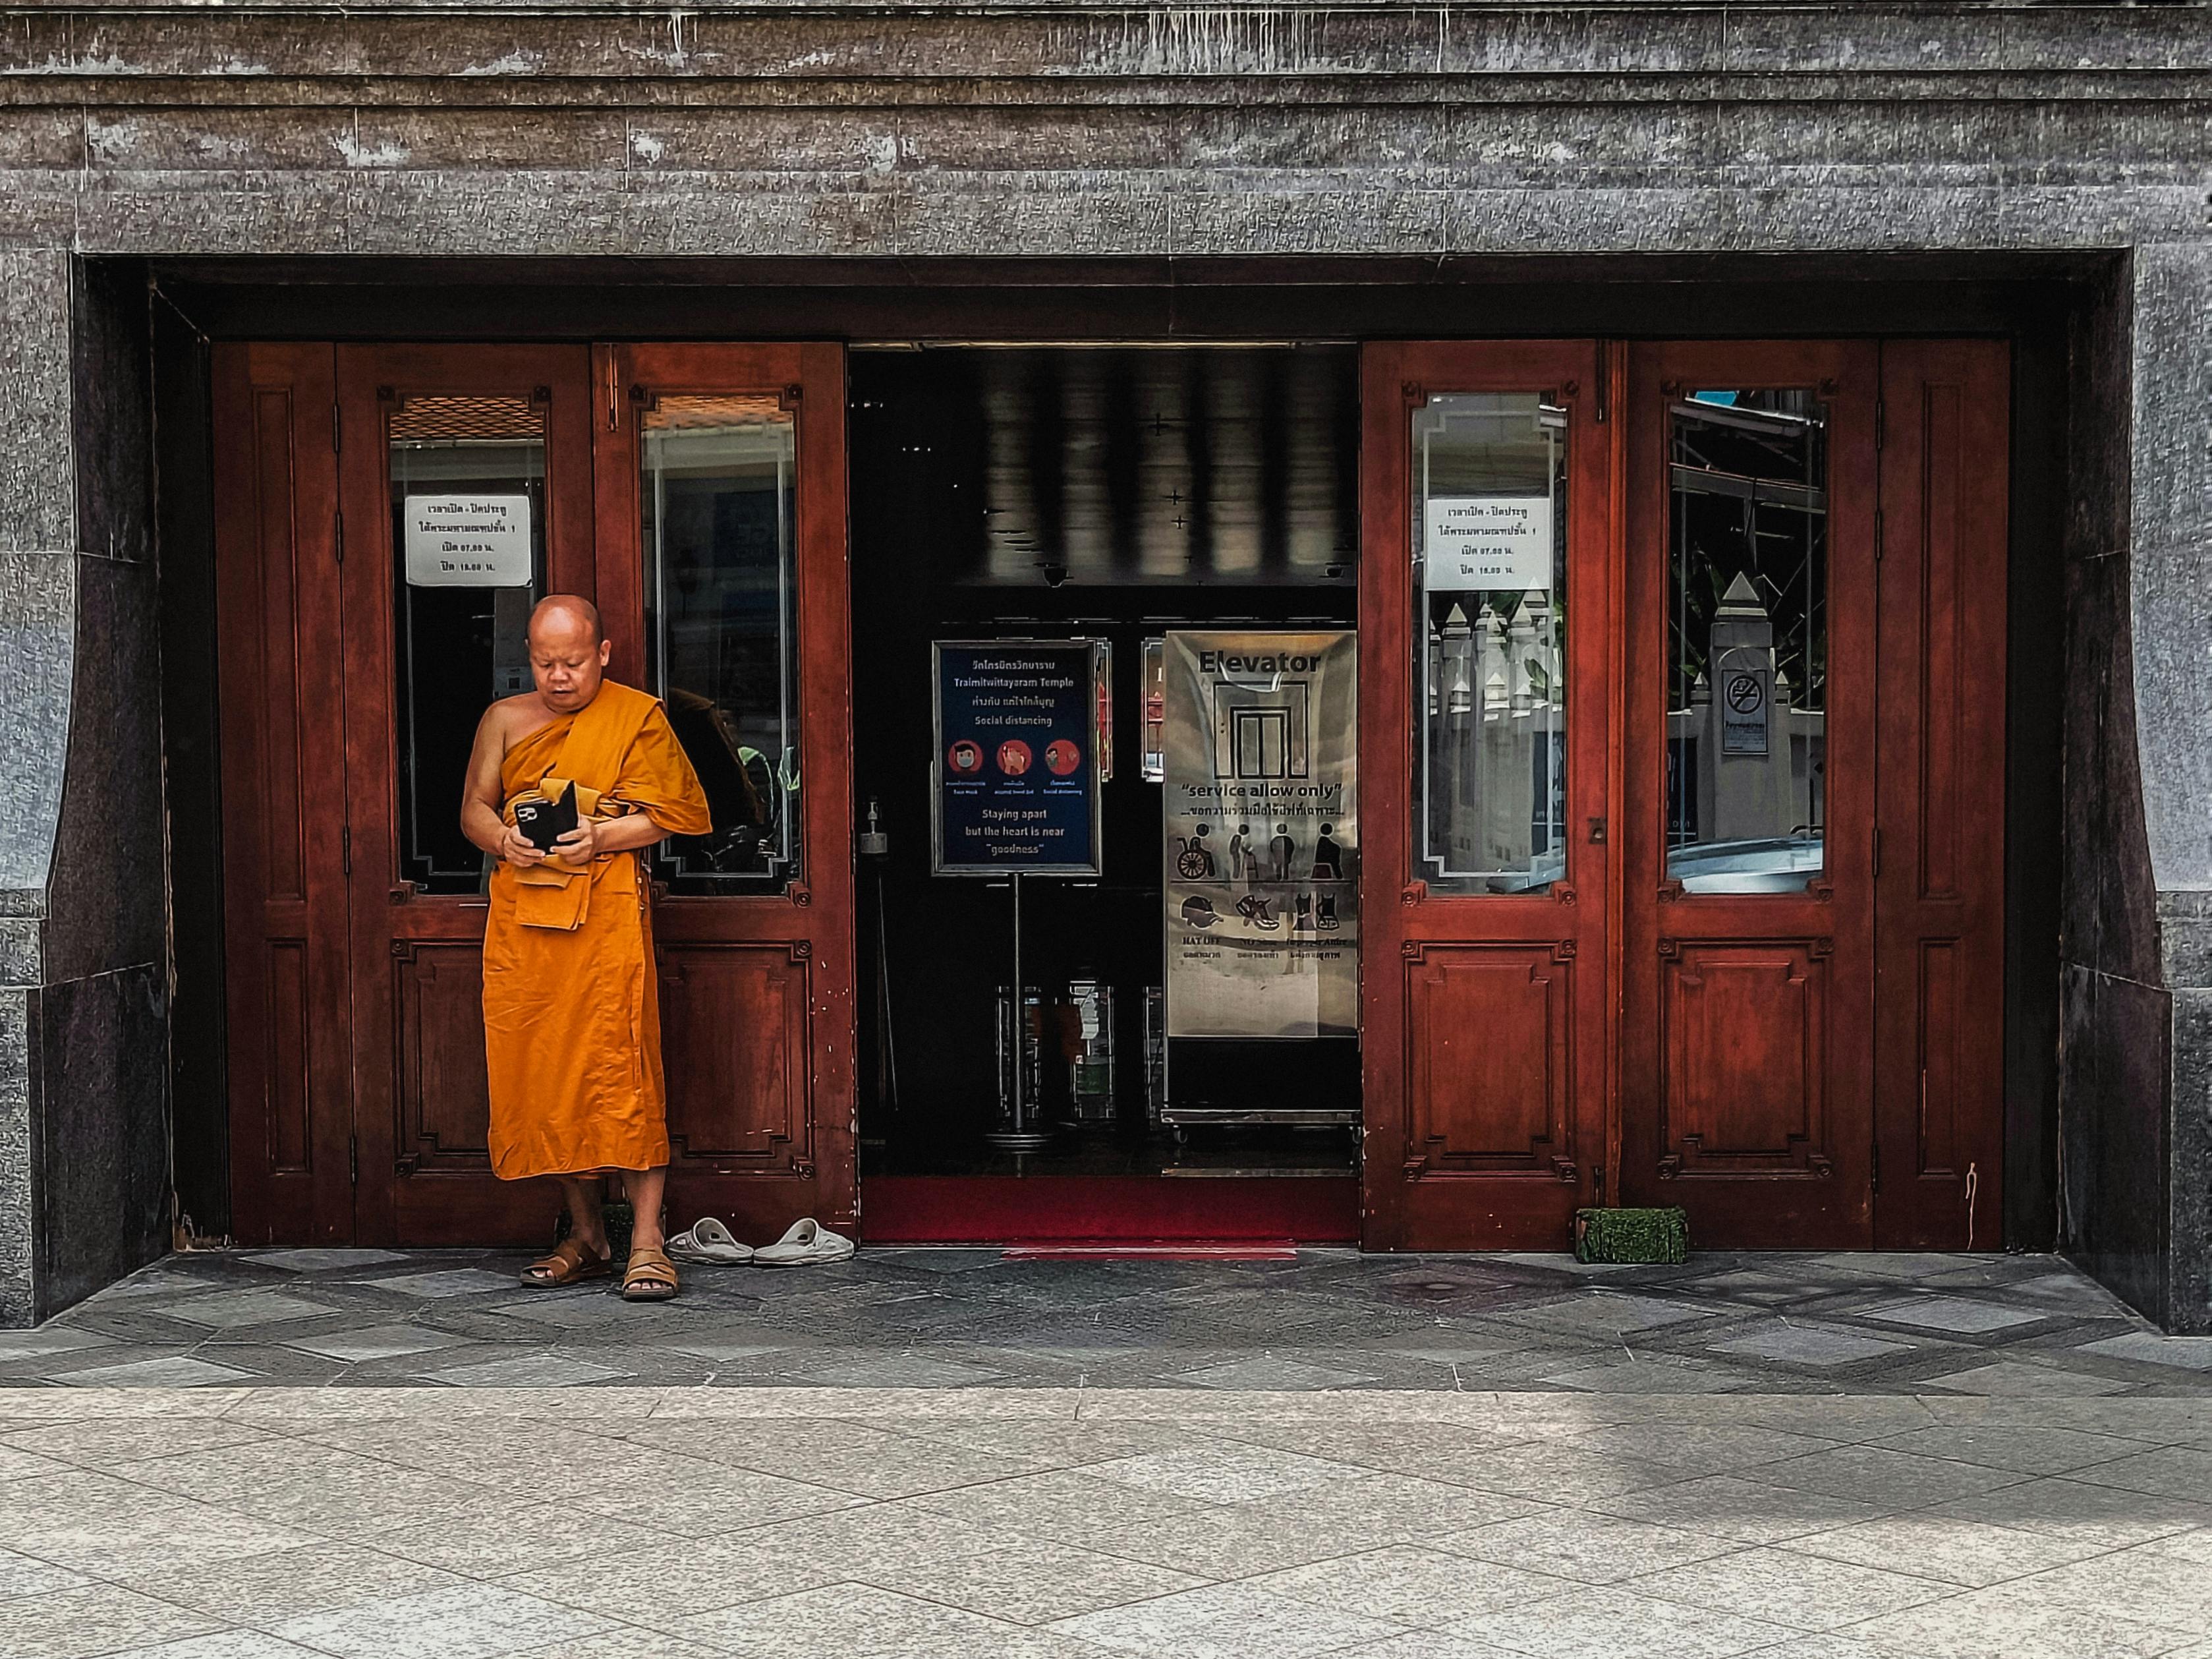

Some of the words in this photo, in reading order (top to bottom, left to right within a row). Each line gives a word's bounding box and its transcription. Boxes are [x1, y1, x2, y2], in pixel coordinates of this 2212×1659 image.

[1199, 651, 1321, 674] Elevator
[1040, 677, 1074, 689] Temple
[975, 715, 1002, 725] Social
[1006, 715, 1052, 727] distancing
[1249, 782, 1294, 797] allow
[982, 808, 1019, 821] Staying
[1021, 809, 1047, 821] apart
[965, 827, 981, 836] but
[984, 827, 1000, 836] the
[1003, 827, 1028, 836] heart
[1031, 827, 1040, 836] is
